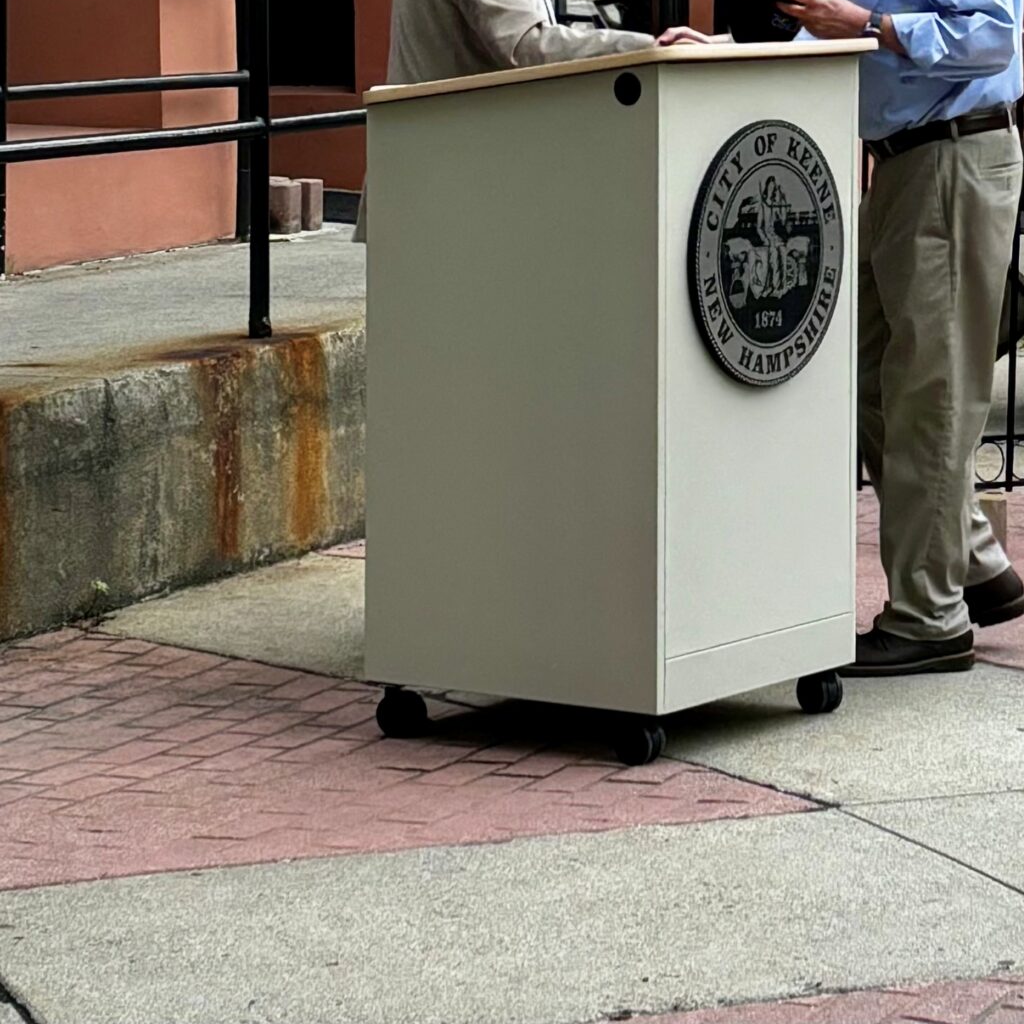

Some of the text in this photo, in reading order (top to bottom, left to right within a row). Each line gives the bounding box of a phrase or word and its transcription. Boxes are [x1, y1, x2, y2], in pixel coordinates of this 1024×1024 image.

[706, 133, 836, 231] CITY OF KEENE
[704, 266, 837, 374] NEW HAMPSHIRE
